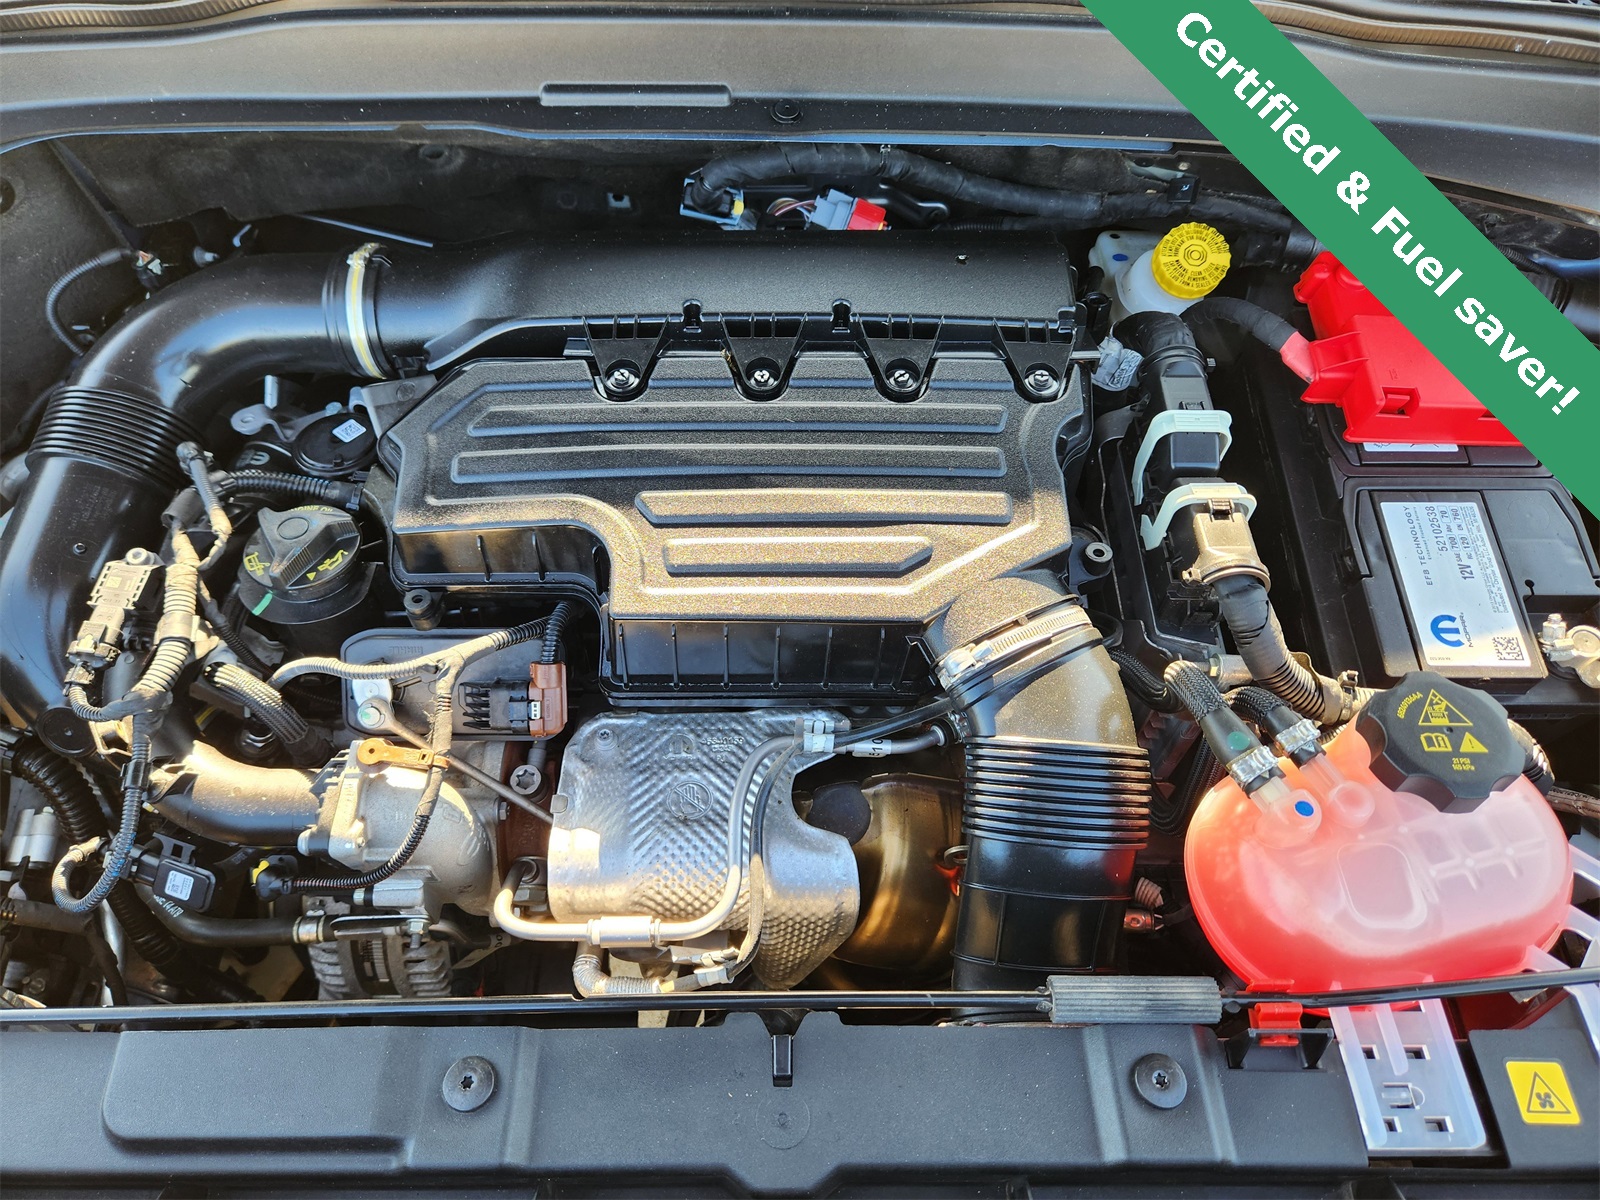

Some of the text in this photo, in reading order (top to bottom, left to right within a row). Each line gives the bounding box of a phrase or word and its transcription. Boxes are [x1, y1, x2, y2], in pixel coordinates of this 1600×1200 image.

[1440, 510, 1448, 518] 70
[1451, 509, 1460, 520] 760
[1425, 506, 1448, 551] 52102538
[1403, 506, 1433, 585] EFB TECHNOLOGY
[1449, 537, 1458, 549] 700
[1460, 537, 1470, 549] 120
[1454, 553, 1462, 562] SAE
[1458, 564, 1474, 580] 12V
[1459, 614, 1473, 647] MOPAR
